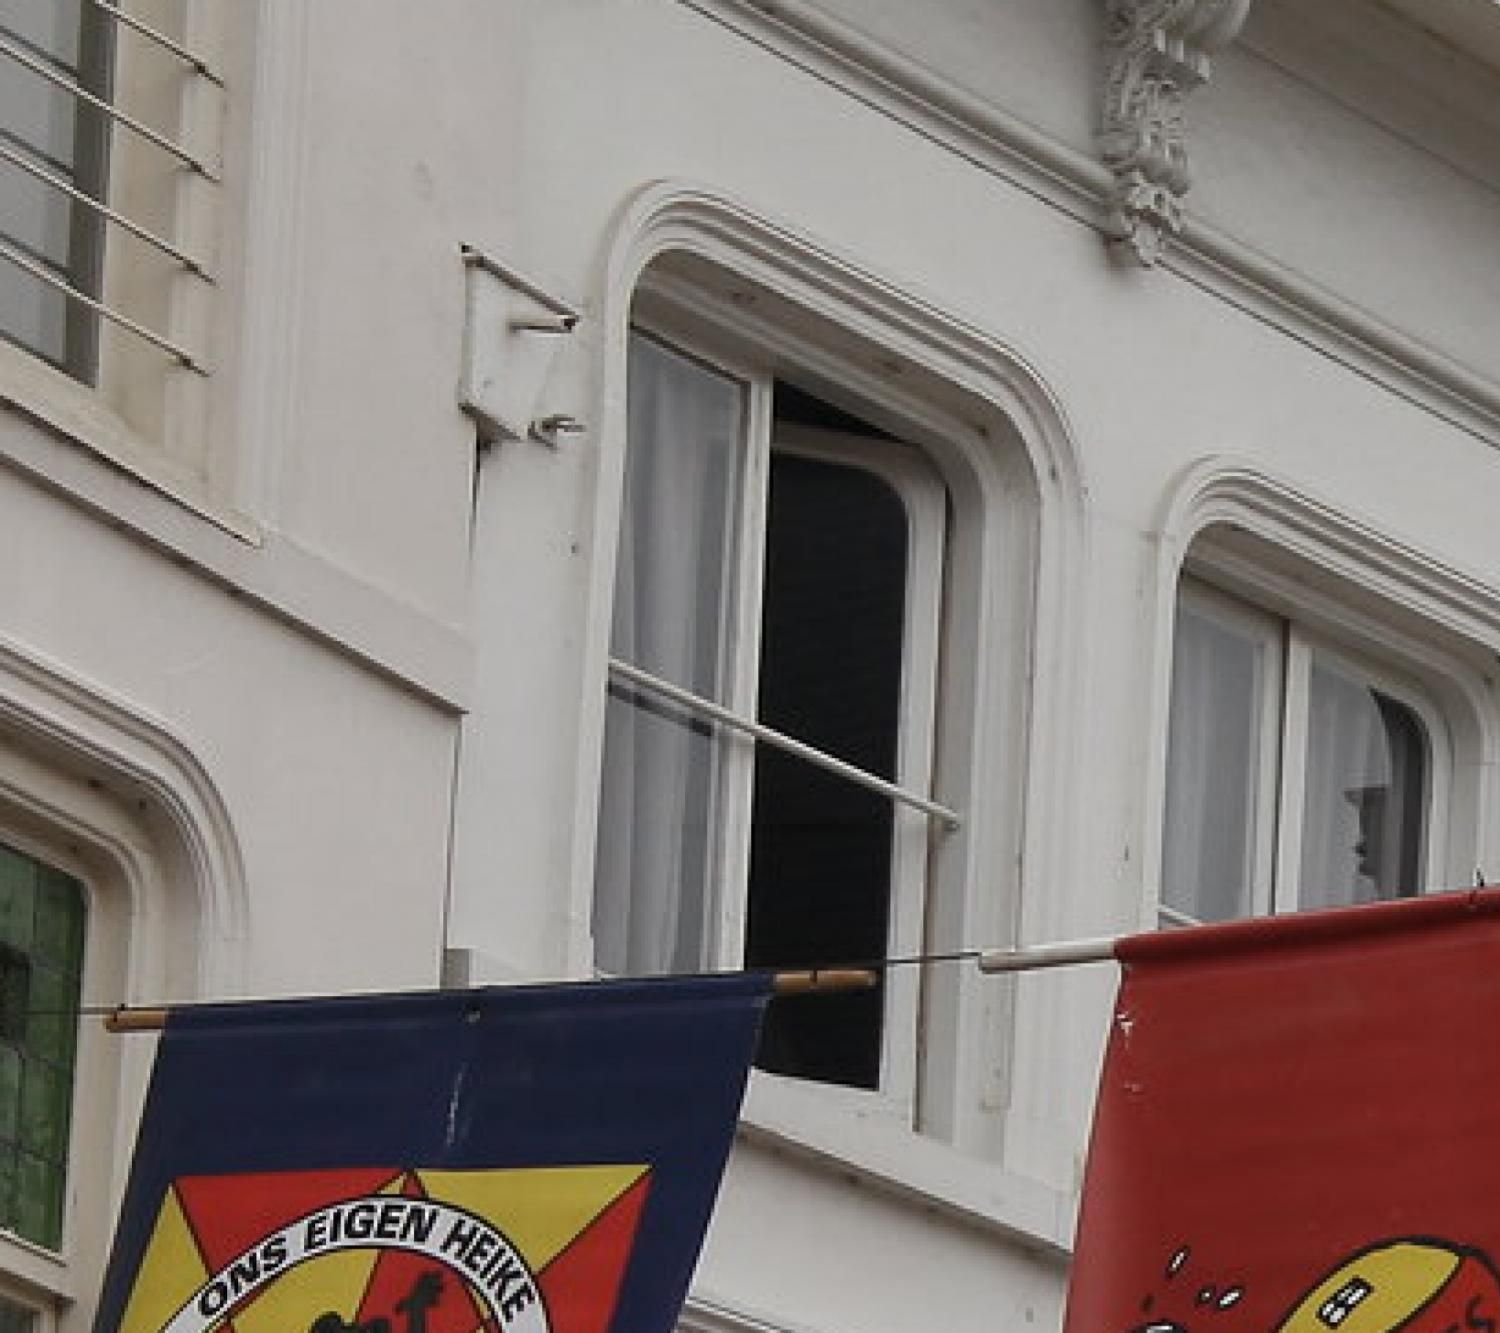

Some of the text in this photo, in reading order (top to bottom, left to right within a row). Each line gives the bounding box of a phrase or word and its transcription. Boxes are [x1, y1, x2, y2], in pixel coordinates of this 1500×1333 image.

[197, 1204, 536, 1322] ONS EIGEN HEIKE
